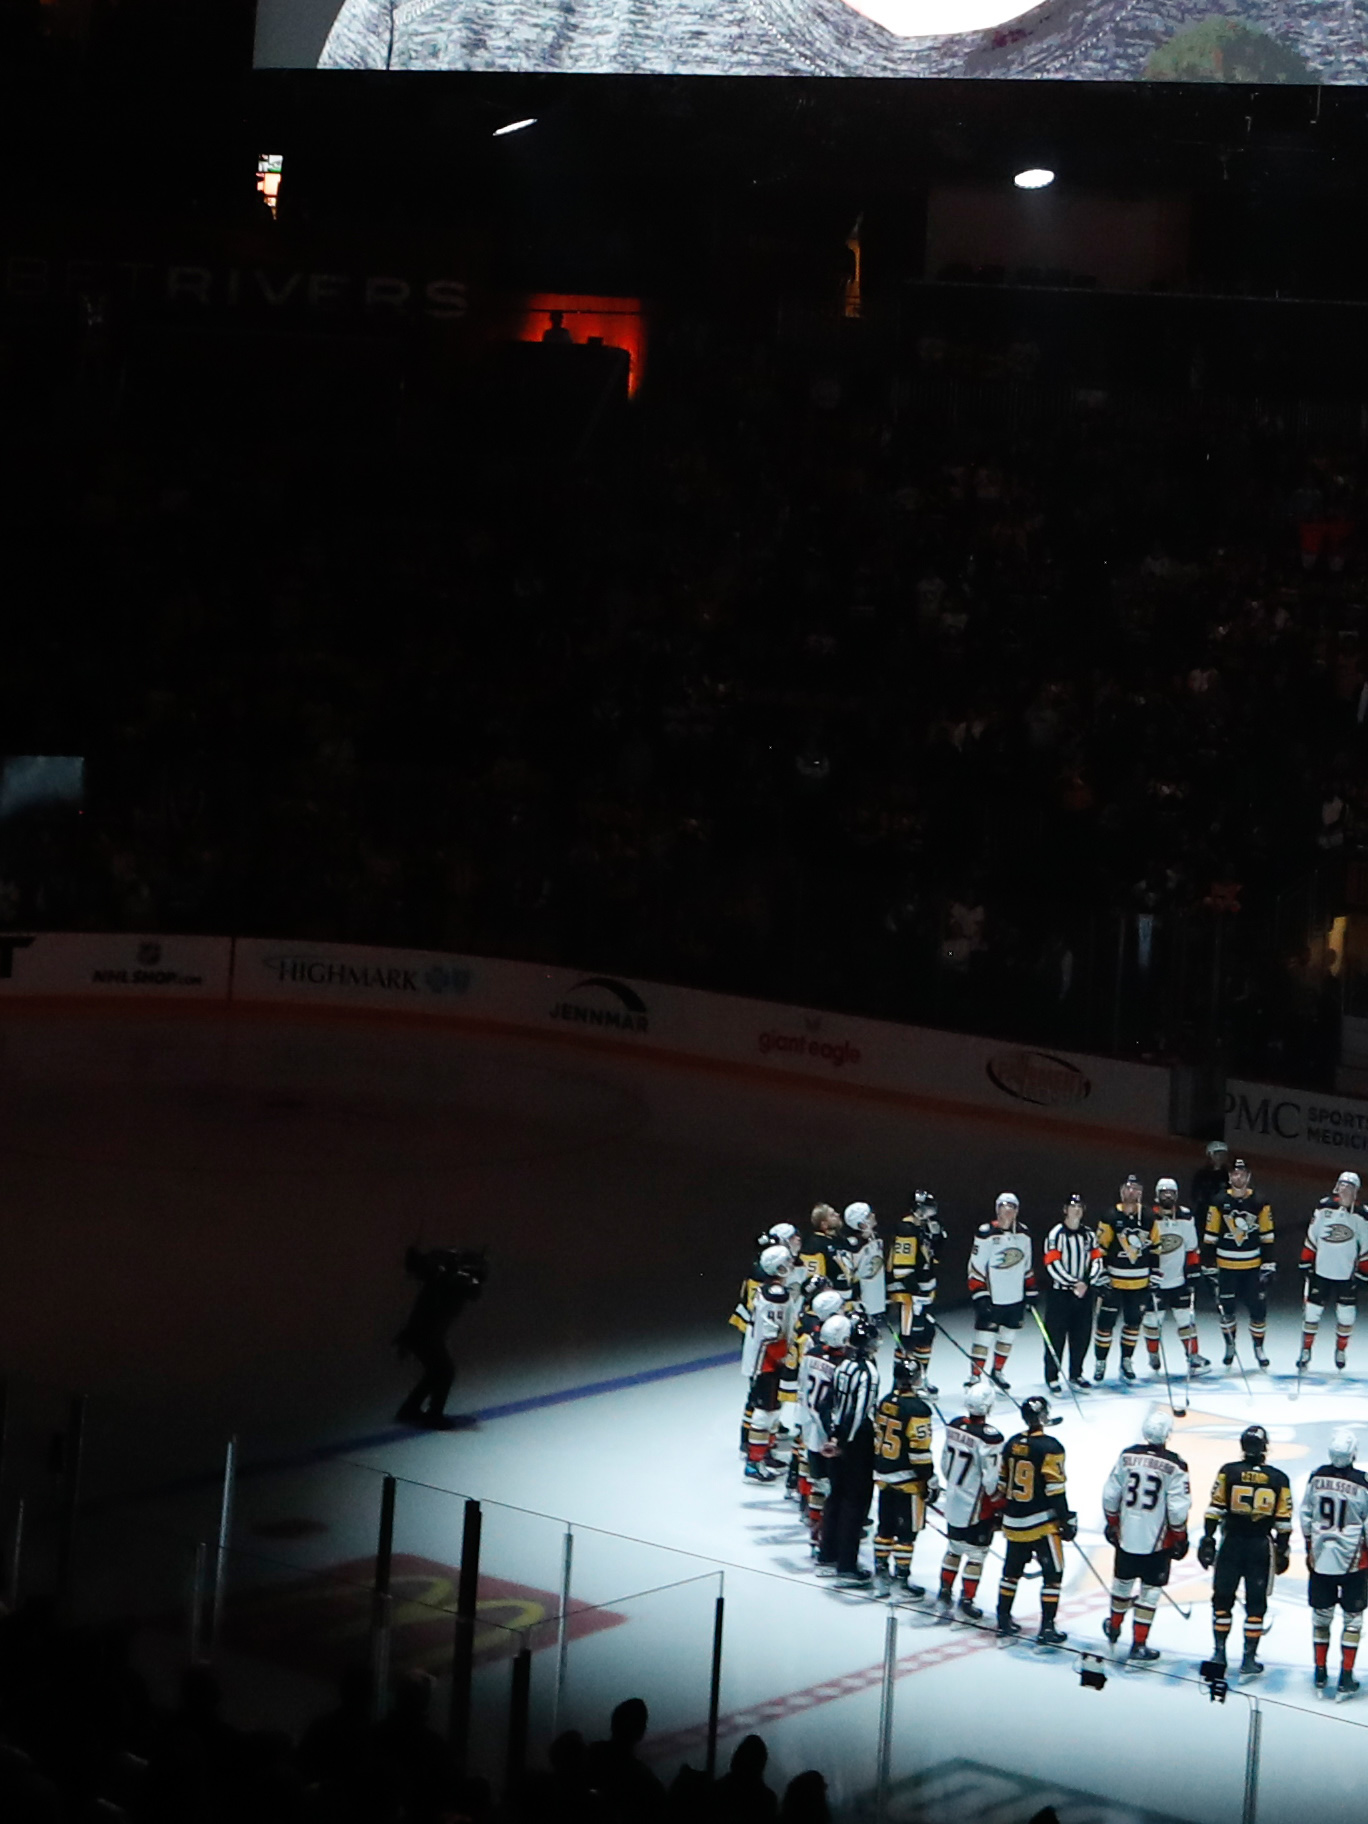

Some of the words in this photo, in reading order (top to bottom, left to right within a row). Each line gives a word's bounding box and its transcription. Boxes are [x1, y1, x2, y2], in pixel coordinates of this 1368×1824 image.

[279, 958, 417, 992] HIGHMARK
[549, 1002, 650, 1035] JENNMAR
[758, 1028, 807, 1054] giant
[807, 1036, 862, 1067] eagle
[947, 1445, 974, 1486] 77
[1007, 1456, 1036, 1503] 19
[1125, 1471, 1163, 1511] 33
[1319, 1496, 1348, 1533] 91
